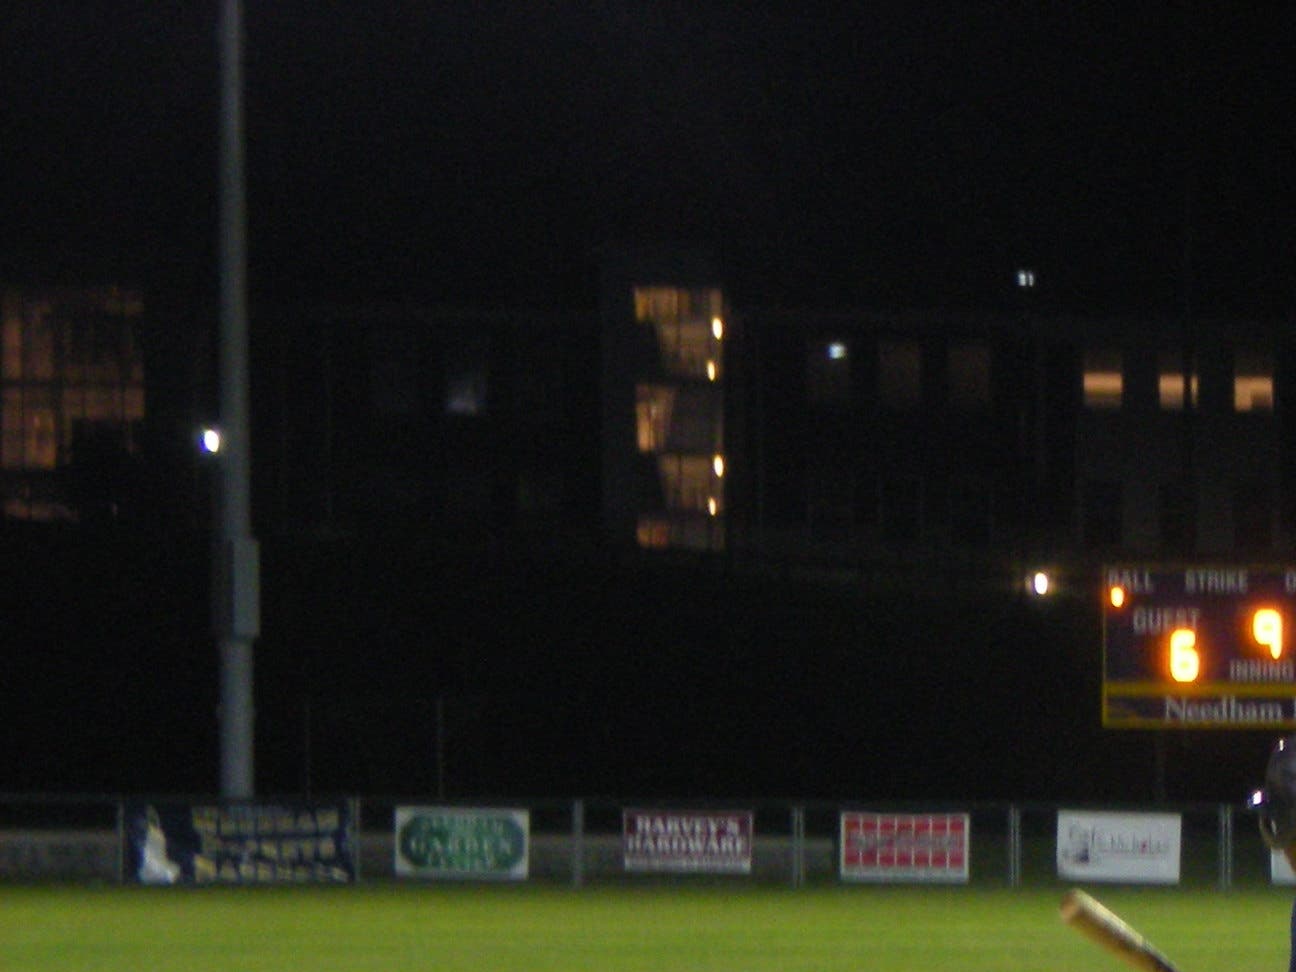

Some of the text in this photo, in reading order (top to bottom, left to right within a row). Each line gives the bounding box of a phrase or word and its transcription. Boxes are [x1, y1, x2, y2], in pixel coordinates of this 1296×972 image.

[1107, 569, 1152, 593] BALL
[1185, 570, 1248, 593] STRIKE
[1133, 607, 1199, 633] GUEST
[1253, 608, 1282, 660] 9
[1170, 628, 1199, 683] 6
[1230, 659, 1294, 682] INNING
[1164, 696, 1283, 723] Needham
[636, 815, 741, 834] HARVEY'S
[627, 835, 745, 853] HARDWARE
